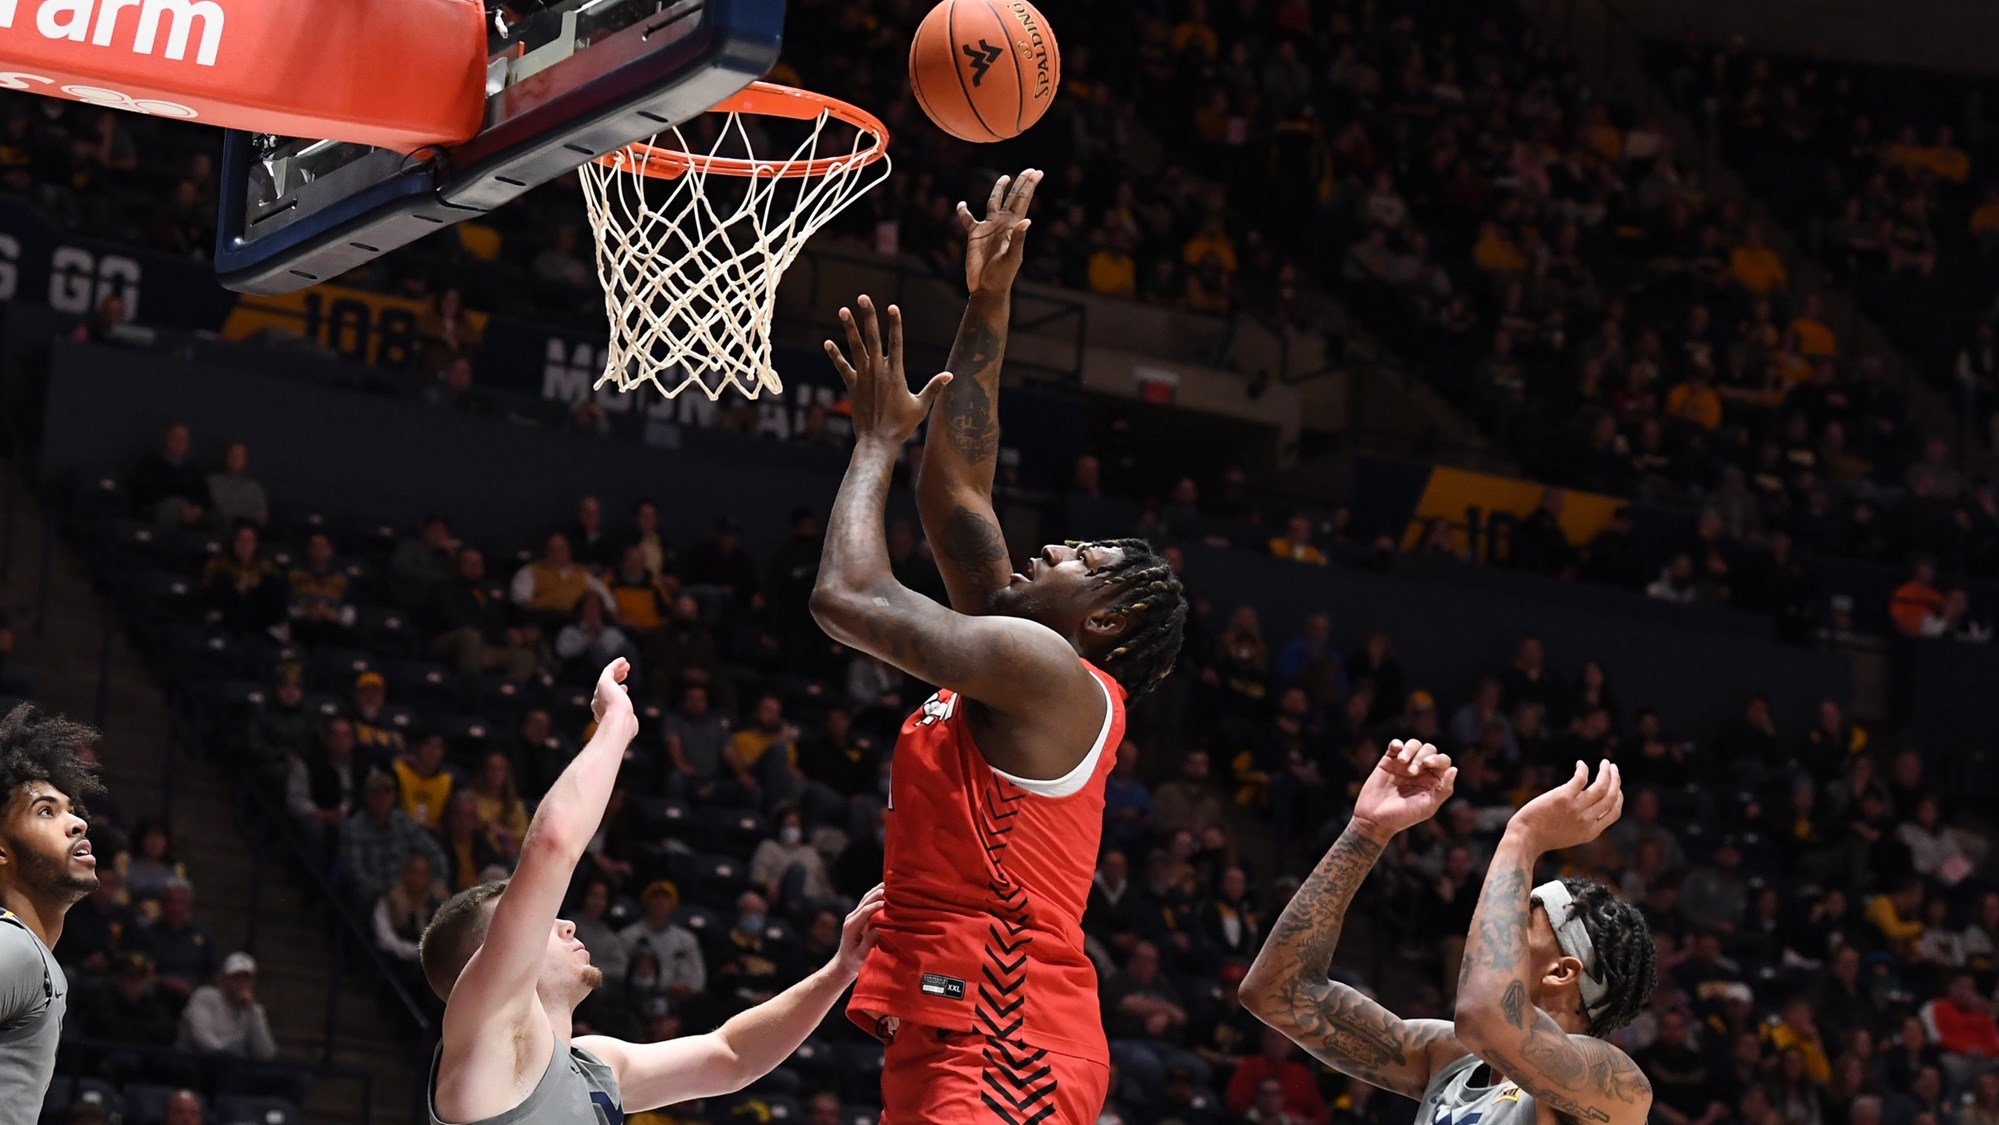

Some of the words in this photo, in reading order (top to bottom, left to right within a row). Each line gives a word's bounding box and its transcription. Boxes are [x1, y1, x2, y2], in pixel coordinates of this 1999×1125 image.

[1007, 2, 1050, 99] SPALDING
[48, 244, 142, 324] GO
[306, 293, 415, 368] 108
[947, 984, 961, 993] XXL
